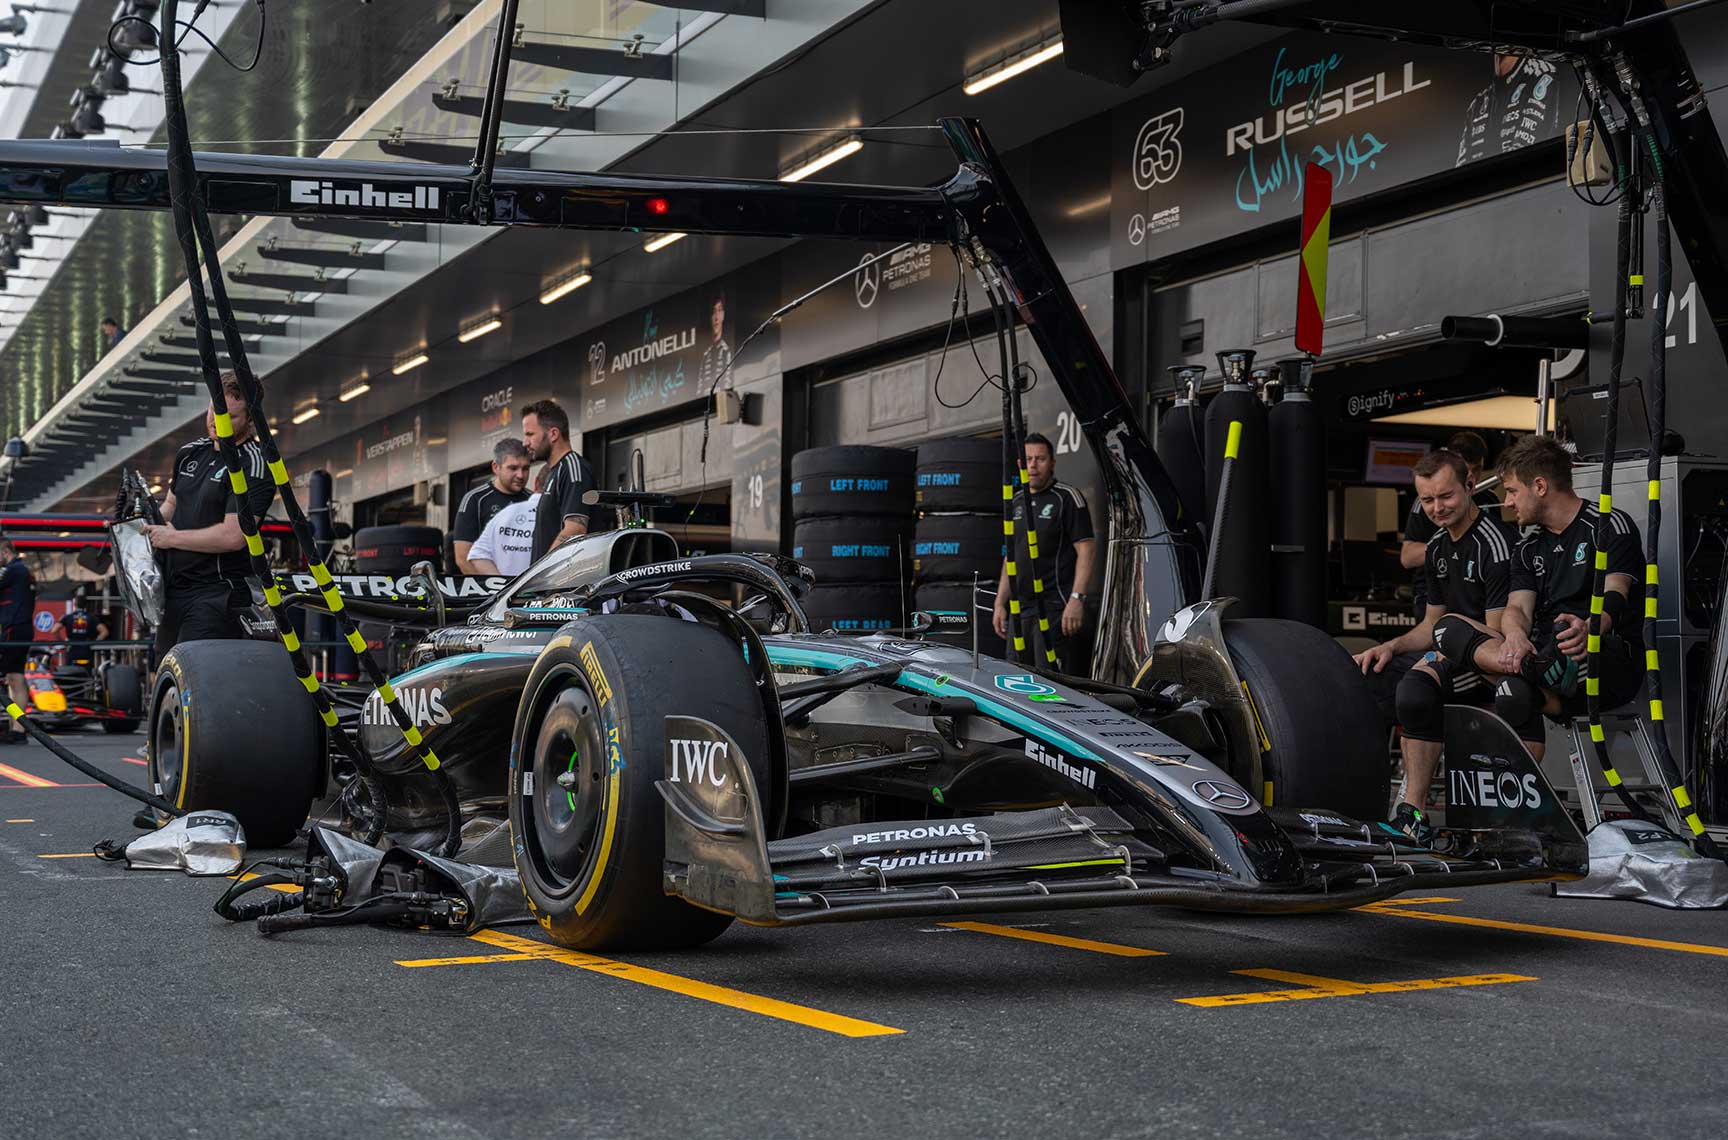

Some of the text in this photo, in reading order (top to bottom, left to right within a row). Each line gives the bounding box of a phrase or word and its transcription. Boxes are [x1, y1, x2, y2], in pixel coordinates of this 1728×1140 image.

[1269, 48, 1344, 125] George
[1226, 61, 1432, 156] RUSSELL
[1521, 117, 1538, 131] IWC
[1132, 107, 1185, 191] 63
[291, 180, 439, 210] Einhell
[882, 255, 931, 282] PETRONAS
[1652, 282, 1697, 348] 21
[588, 341, 607, 385] 12
[611, 327, 697, 373] ANTONELLI
[481, 386, 513, 412] ORACLE
[366, 429, 414, 460] VERSTAPPEN
[1056, 411, 1081, 455] 20
[748, 475, 763, 508] 19
[830, 479, 889, 491] LEFT FRONT
[932, 473, 961, 486] FRONT
[832, 545, 890, 557] RIGHT FRONT
[932, 542, 960, 555] FRONT
[620, 562, 692, 582] CROWDSTRIKE
[37, 614, 53, 632] hp
[529, 612, 578, 621] PETRONAS
[939, 615, 968, 624] PETRONAS
[360, 687, 452, 727] ETRNAS
[670, 739, 728, 787] IWC
[1025, 738, 1096, 790] Einhell
[1449, 769, 1542, 809] INEOS
[852, 823, 976, 845] PETRONAS
[858, 850, 985, 871] Syntium
